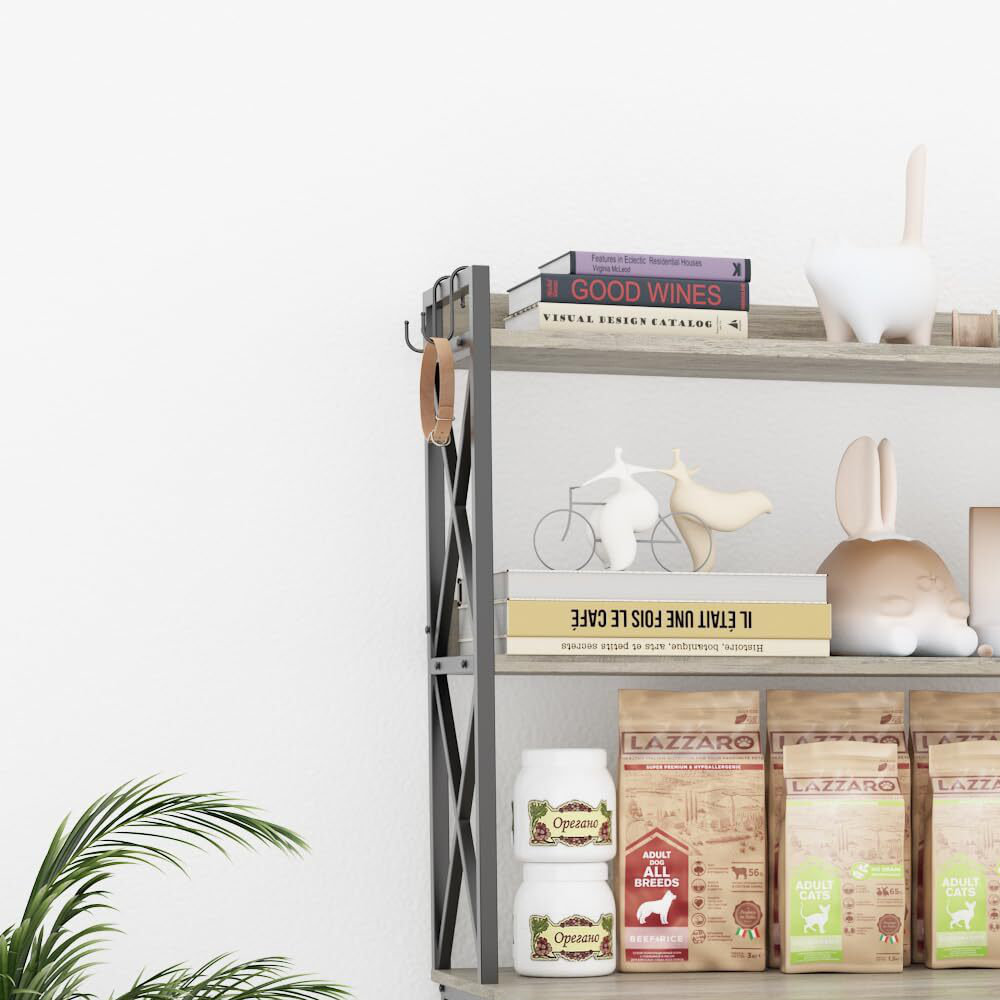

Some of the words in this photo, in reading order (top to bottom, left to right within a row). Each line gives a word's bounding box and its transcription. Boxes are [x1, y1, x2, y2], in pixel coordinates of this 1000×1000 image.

[681, 258, 703, 267] Houses
[571, 278, 641, 302] GOOD
[647, 281, 722, 306] WINES
[543, 313, 594, 323] VISUAL
[599, 315, 647, 326] DESIGN
[651, 318, 713, 329] CATALOG
[571, 609, 607, 631] CAFÉ
[611, 609, 627, 628] LE
[631, 609, 662, 628] FOIS
[666, 610, 694, 628] UNE
[698, 610, 736, 632] ÉTAIT
[740, 610, 752, 629] IL
[561, 641, 598, 651] secrets
[601, 642, 629, 651] petits
[632, 642, 642, 651] et
[645, 642, 666, 651] arts
[631, 735, 755, 750] LAZZARO
[792, 780, 896, 792] LAZZARO
[553, 816, 598, 833] Орегано
[642, 850, 672, 859] ADULT
[643, 866, 671, 878] ALL
[634, 878, 680, 888] BREEDS
[795, 880, 833, 890] ADULT
[942, 877, 980, 887] ADULT
[799, 890, 831, 900] CATS
[945, 887, 977, 897] CATS
[554, 931, 600, 948] Орегано
